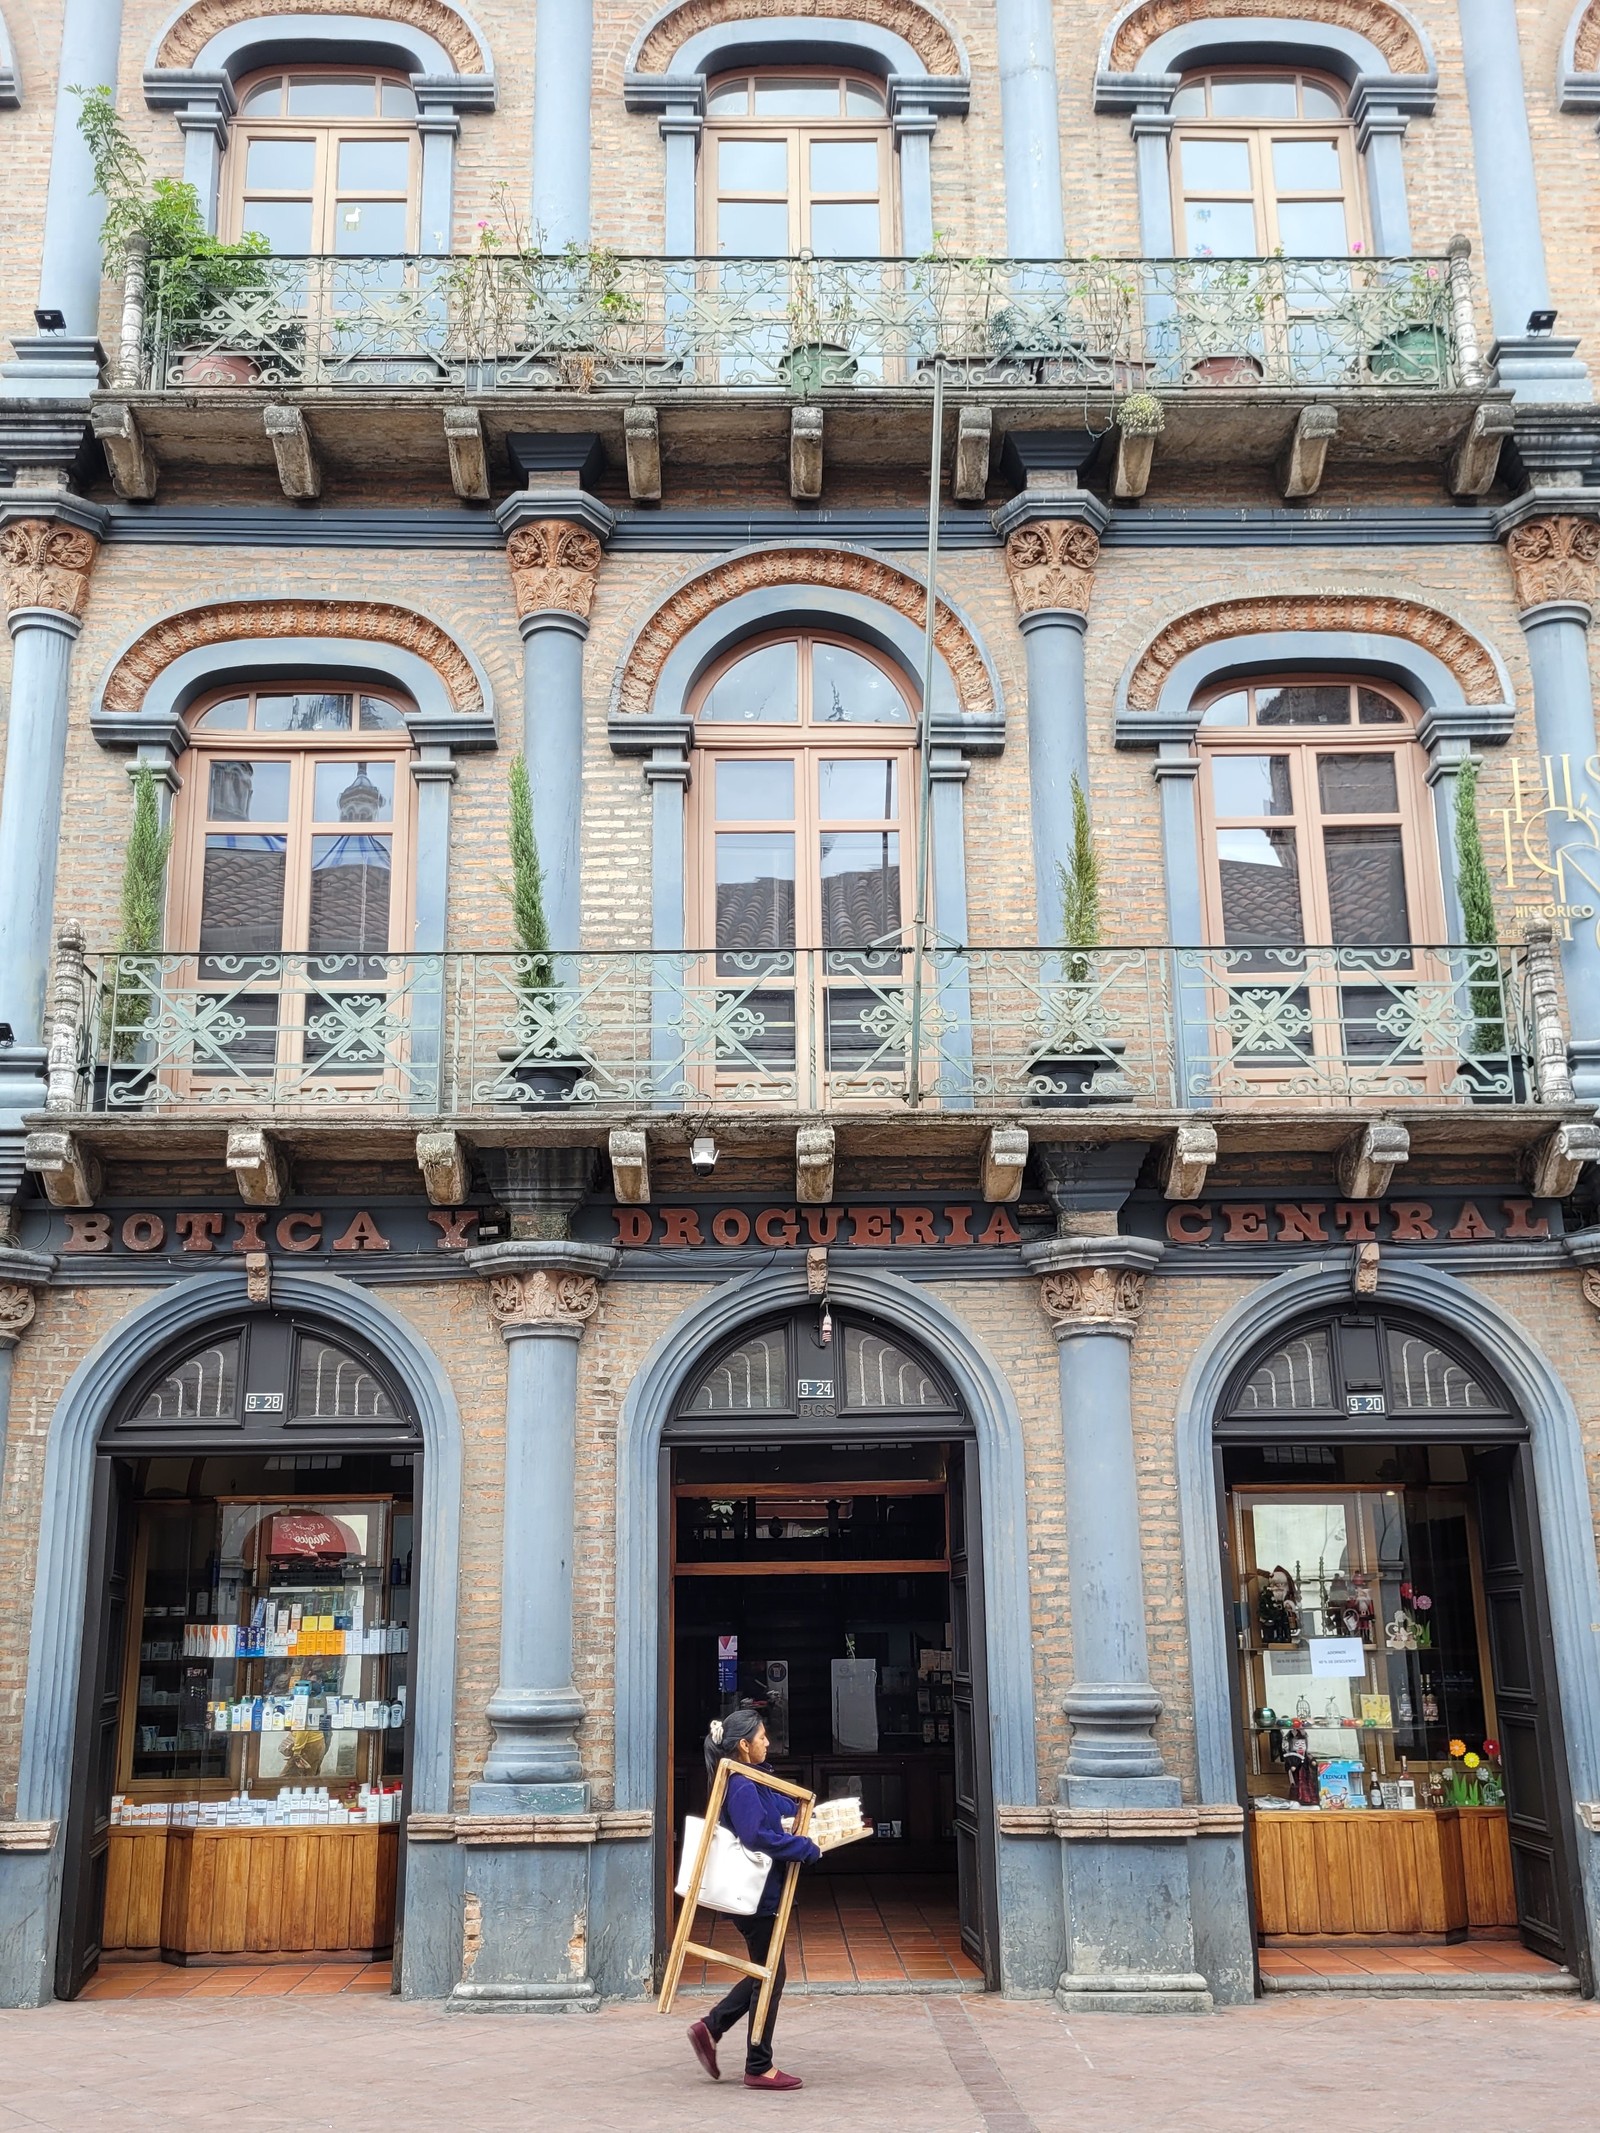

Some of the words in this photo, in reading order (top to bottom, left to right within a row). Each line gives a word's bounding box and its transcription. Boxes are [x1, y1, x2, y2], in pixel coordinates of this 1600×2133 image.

[1515, 902, 1595, 919] HISTÓRICO
[63, 1211, 390, 1252] BOTICA
[427, 1210, 479, 1249] Y
[612, 1206, 1021, 1246] DROGUERIA
[1166, 1199, 1548, 1243] CENTRAL
[798, 1403, 836, 1418] BGS
